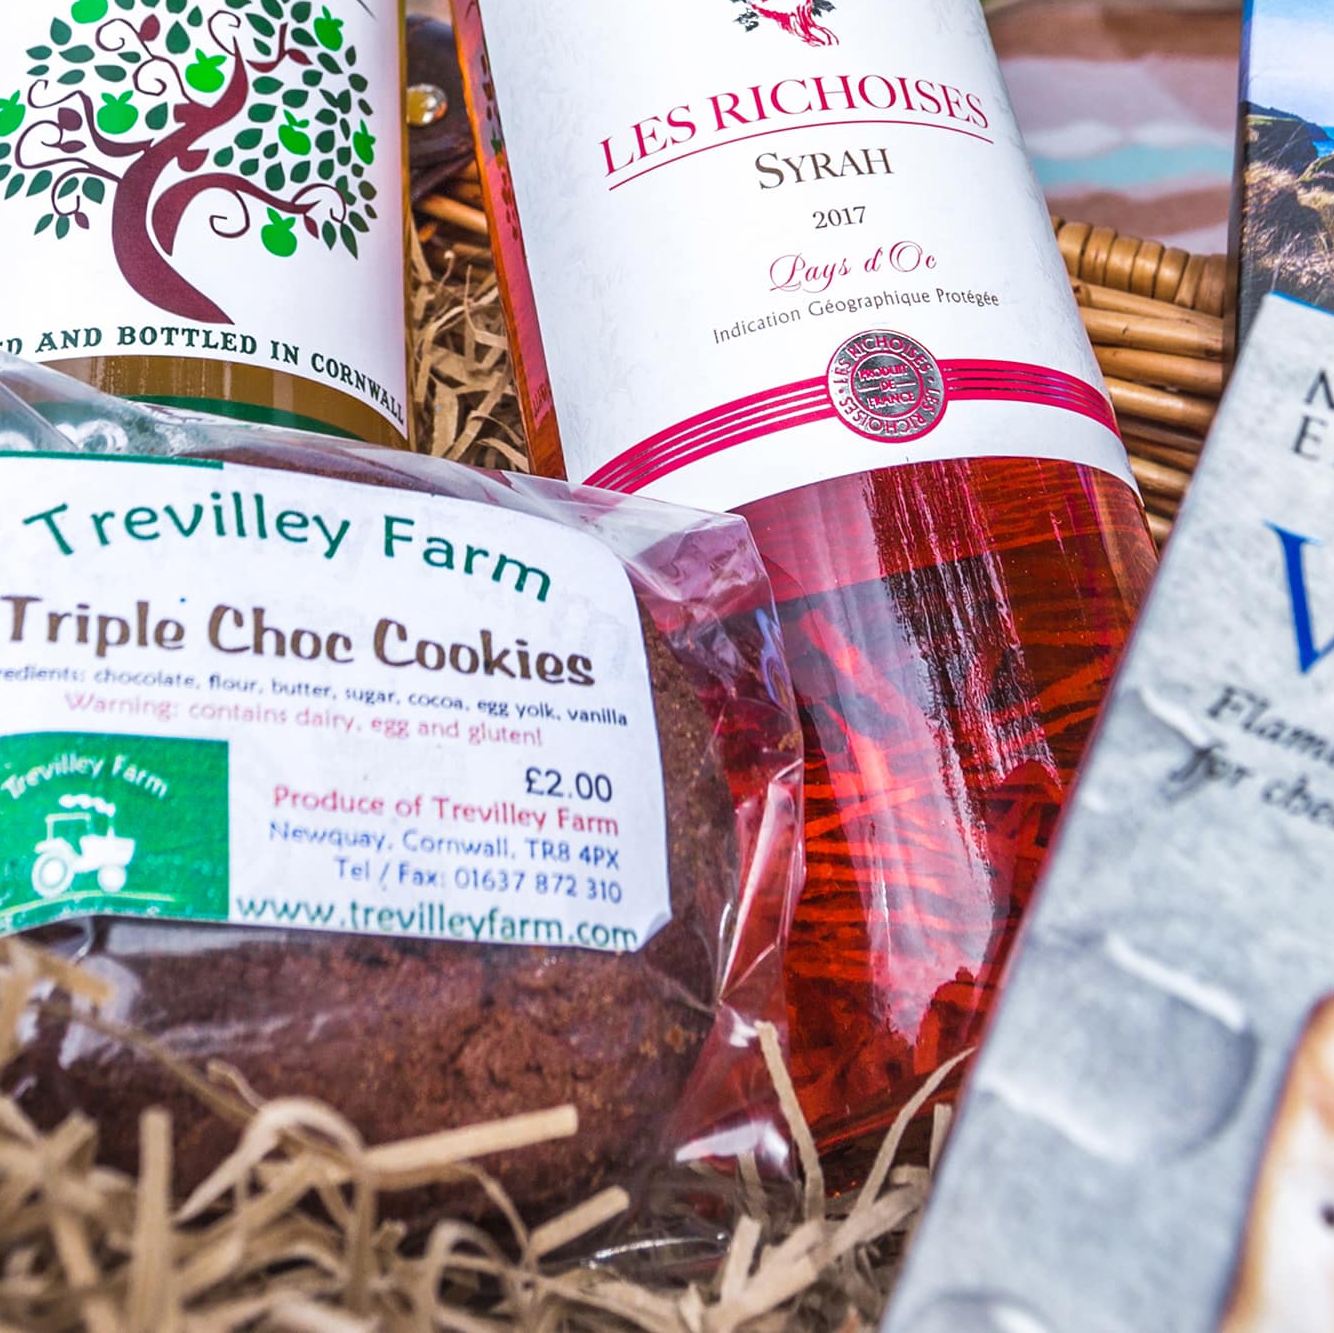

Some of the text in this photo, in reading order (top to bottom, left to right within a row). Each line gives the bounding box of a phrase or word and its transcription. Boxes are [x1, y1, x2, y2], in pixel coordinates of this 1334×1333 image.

[598, 74, 990, 178] LES RICHOISES
[812, 205, 868, 230] 2017
[768, 252, 852, 294] Pays
[713, 286, 1001, 345] Indication Géographique Protégée
[35, 327, 103, 354] AND
[117, 326, 258, 355] BOTTLED
[270, 341, 300, 365] IN
[310, 352, 405, 424] CORNWALL
[833, 335, 934, 384] LES RICHOISES
[858, 364, 908, 382] PRODUIT
[867, 392, 916, 409] FRANCE
[880, 379, 896, 392] DE
[839, 397, 926, 434] RICHOISES
[22, 491, 552, 603] Trevilley Farm
[0, 596, 597, 688] Triple Choc Cookies
[66, 693, 543, 748] Warning: contains dairy, egg and gluten!
[93, 669, 202, 690] chocolate,
[208, 675, 264, 696] flour,
[271, 677, 338, 701] butter,
[344, 686, 401, 708] sugar,
[408, 691, 470, 712] cocoa,
[477, 701, 509, 717] egg
[567, 707, 628, 727] vanilla
[0, 752, 170, 800] Trevilley Farm
[525, 767, 614, 803] £2.00
[1166, 741, 1251, 802] for
[273, 783, 620, 837] Produce of Trevilley Farm
[524, 837, 569, 863] TR8
[578, 845, 621, 871] 4PX
[334, 856, 622, 904] Tel / Fax: 01637 872 310
[235, 895, 638, 951] www.trevilleyfarm.com
